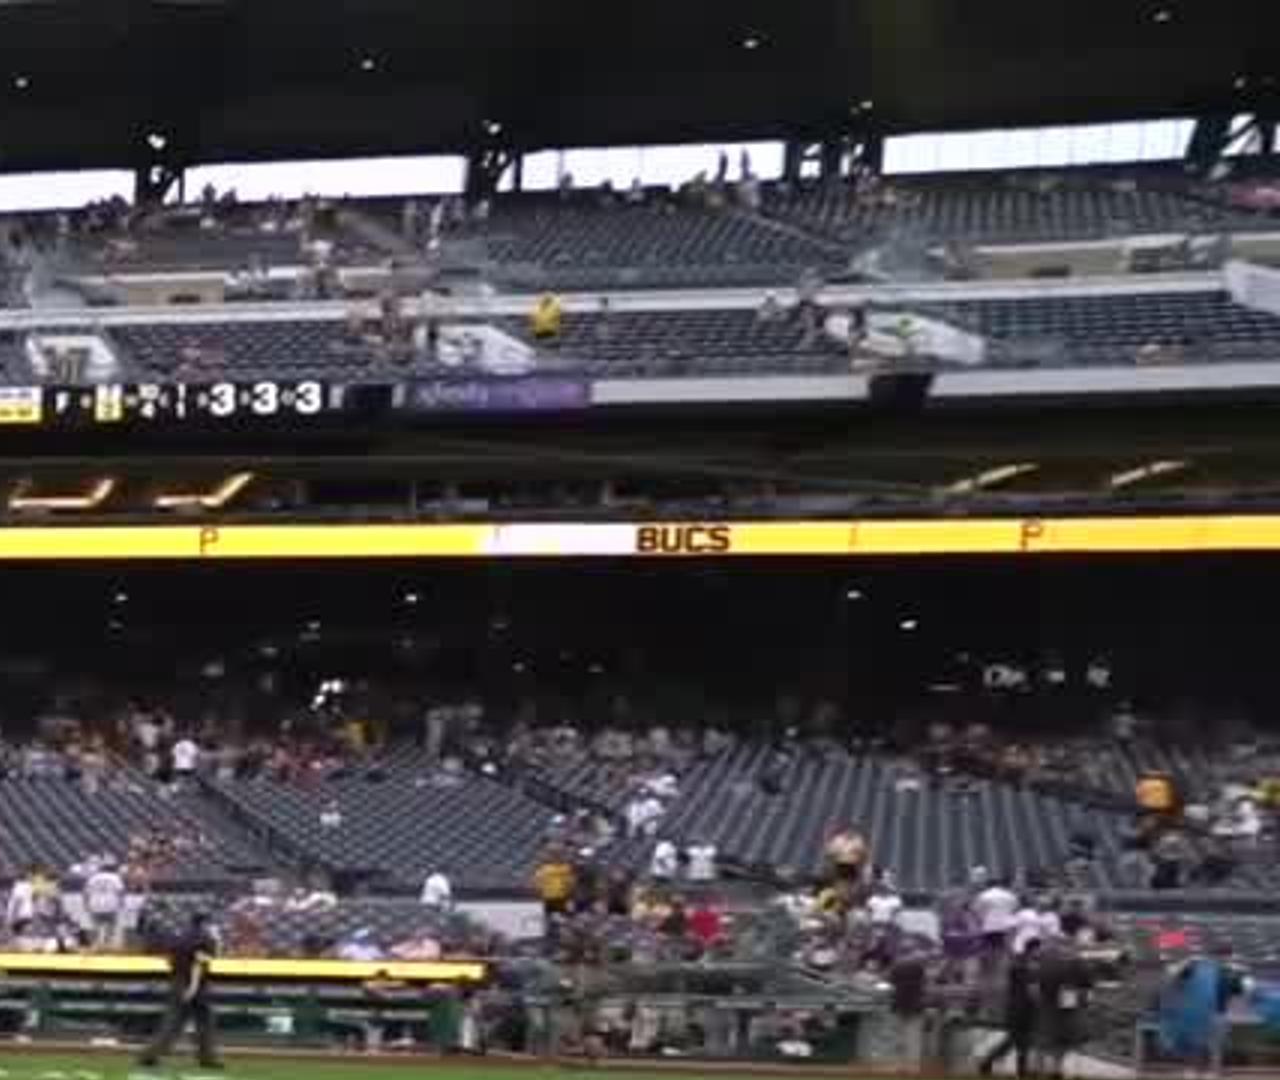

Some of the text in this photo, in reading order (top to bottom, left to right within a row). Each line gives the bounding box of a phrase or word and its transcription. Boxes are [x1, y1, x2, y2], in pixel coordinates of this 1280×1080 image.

[209, 381, 321, 415] 3 3 3
[199, 528, 219, 555] P
[636, 527, 731, 553] BUCS
